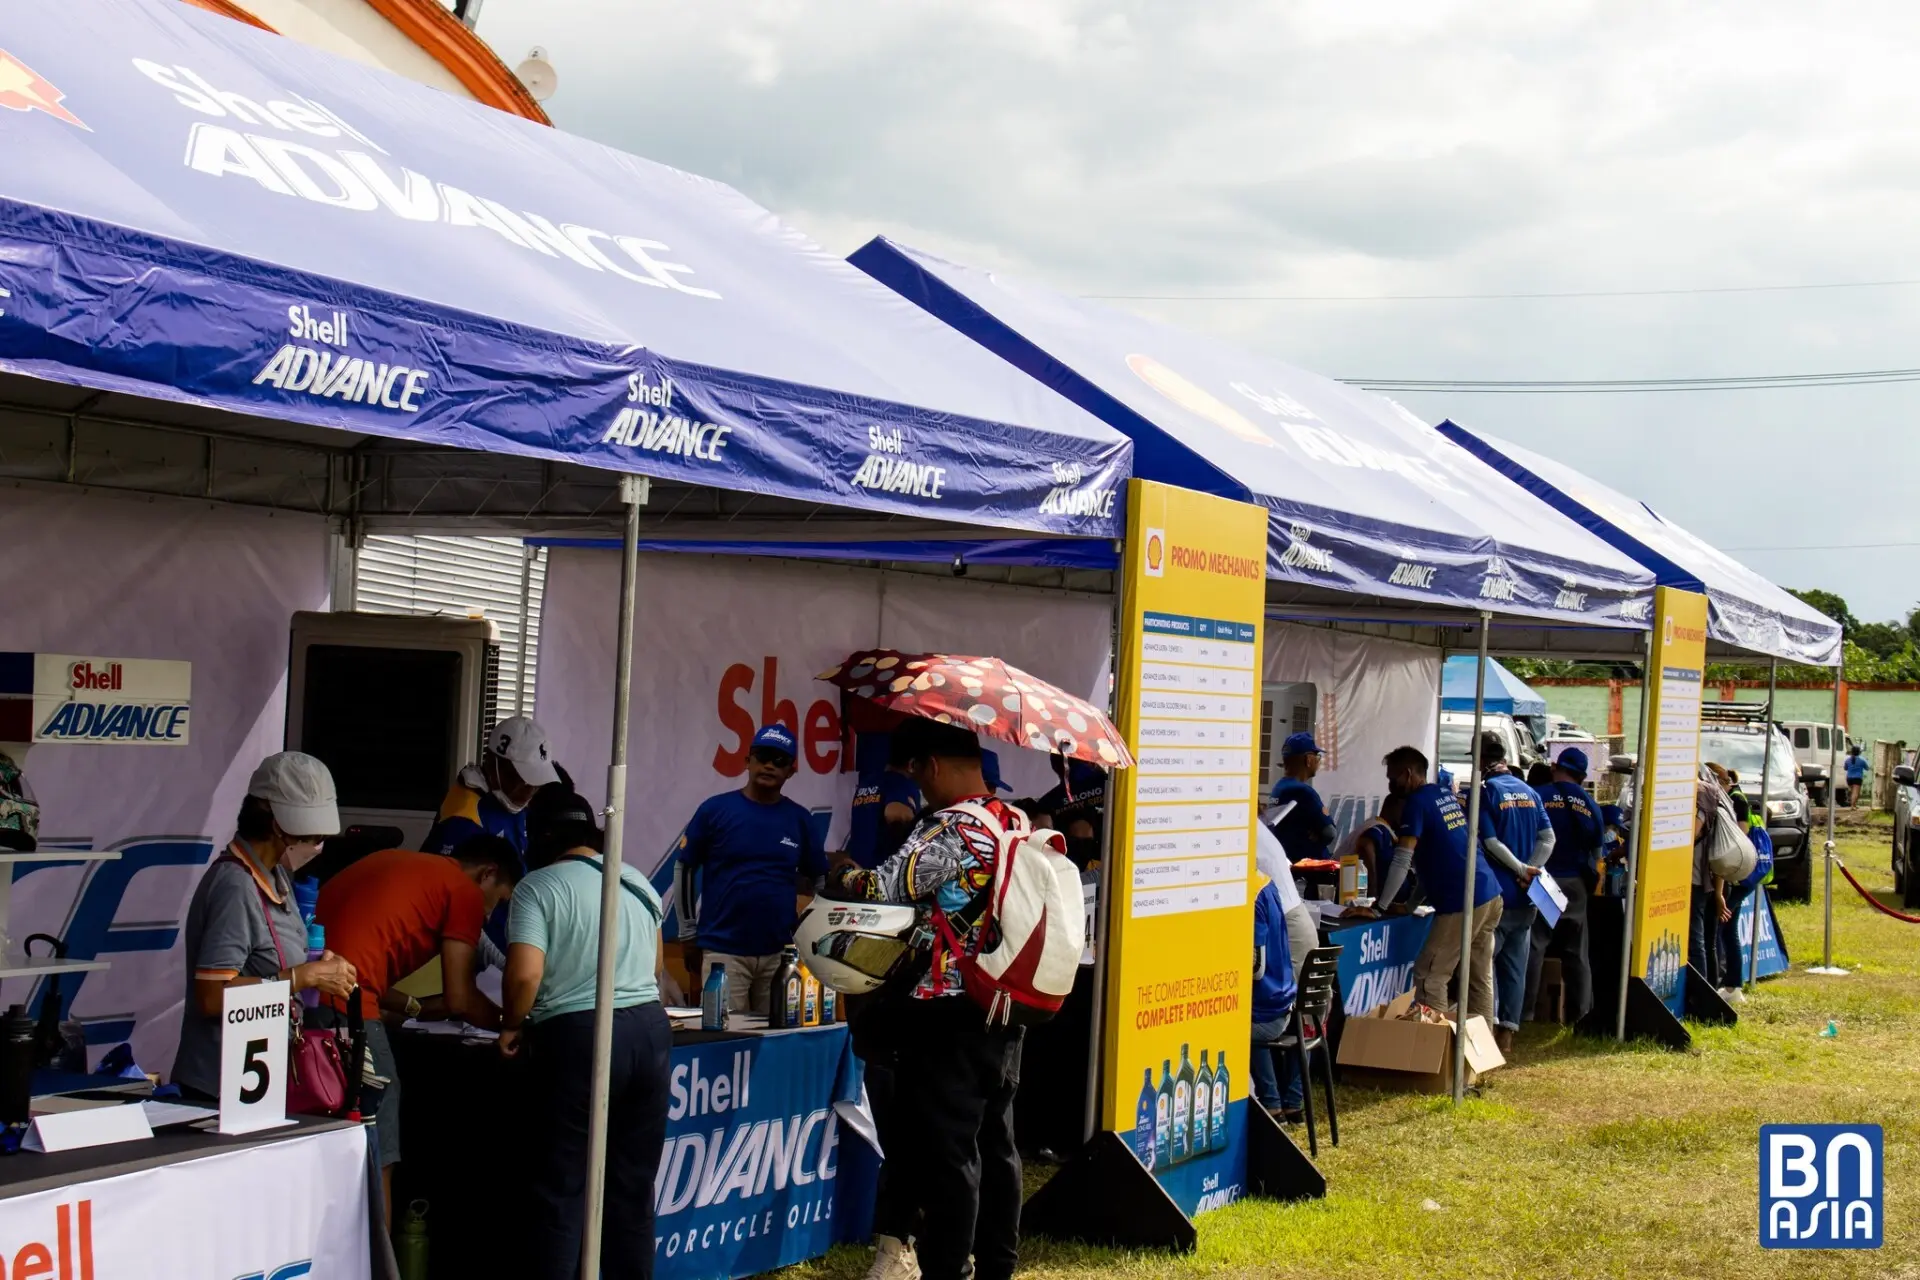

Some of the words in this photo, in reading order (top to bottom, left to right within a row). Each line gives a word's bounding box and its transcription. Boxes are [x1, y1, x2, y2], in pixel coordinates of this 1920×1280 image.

[132, 57, 390, 156] Shell
[184, 121, 723, 300] ADVANCE
[288, 305, 347, 346] Shell
[252, 344, 430, 412] ADVANCE
[627, 374, 672, 408] Shell
[602, 407, 731, 462] ADVANCE
[868, 426, 902, 456] Shell
[851, 454, 946, 499] ADVANCE
[1052, 461, 1080, 484] Shell
[1039, 487, 1117, 518] ADVANCE
[1171, 545, 1206, 571] PROMO
[1208, 552, 1260, 580] MECHANICS
[1280, 542, 1334, 573] ADVANCE
[1388, 562, 1437, 589] ADVANCE
[1554, 589, 1588, 612] ADVANCE
[72, 662, 122, 690] Shell
[42, 703, 190, 738] ADVANCE
[1085, 914, 1091, 948] 4
[1359, 924, 1390, 965] Shell
[1138, 985, 1152, 1005] THE
[1154, 978, 1195, 1003] COMPLETE
[1196, 973, 1223, 995] RANGE
[1224, 970, 1240, 989] FOR
[1344, 960, 1415, 1017] ADVANC
[228, 1003, 285, 1024] COUNTER
[1136, 1003, 1184, 1030] COMPLETE
[1186, 994, 1239, 1020] PROTECTION
[239, 1038, 270, 1104] 5
[667, 1050, 751, 1121] Shell
[1202, 1171, 1219, 1192] Shell
[787, 1196, 833, 1229] OILS
